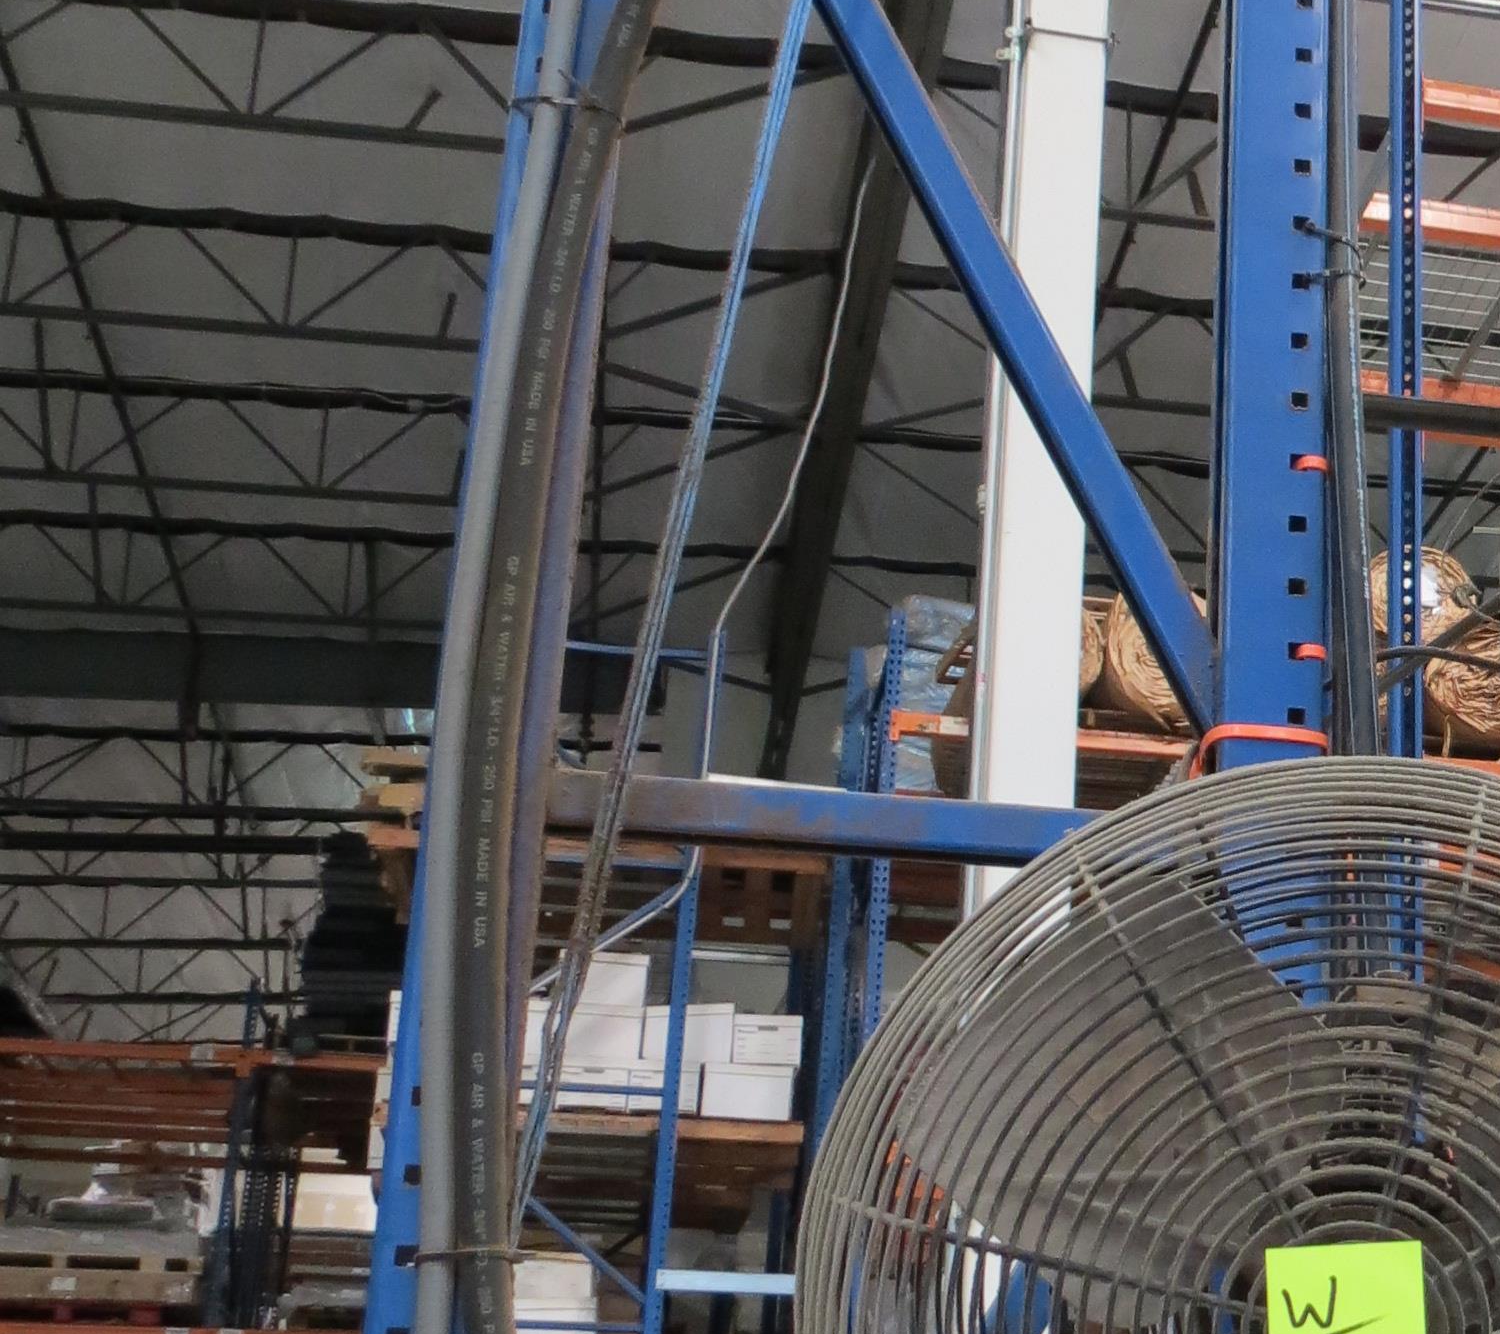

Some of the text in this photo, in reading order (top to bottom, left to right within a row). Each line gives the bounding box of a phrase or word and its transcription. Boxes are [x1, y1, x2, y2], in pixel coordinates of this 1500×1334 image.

[561, 191, 582, 236] WATER
[527, 370, 545, 410] MADE
[525, 417, 537, 431] IN
[519, 437, 534, 467] USA
[482, 764, 496, 790] 250
[479, 798, 493, 823] PSI
[475, 836, 490, 881] MADE
[474, 890, 486, 907] IN
[472, 915, 487, 948] USA
[471, 1051, 484, 1074] GP
[471, 1082, 484, 1108] AIR
[470, 1137, 486, 1195] WATER
[1281, 1275, 1338, 1329] W
